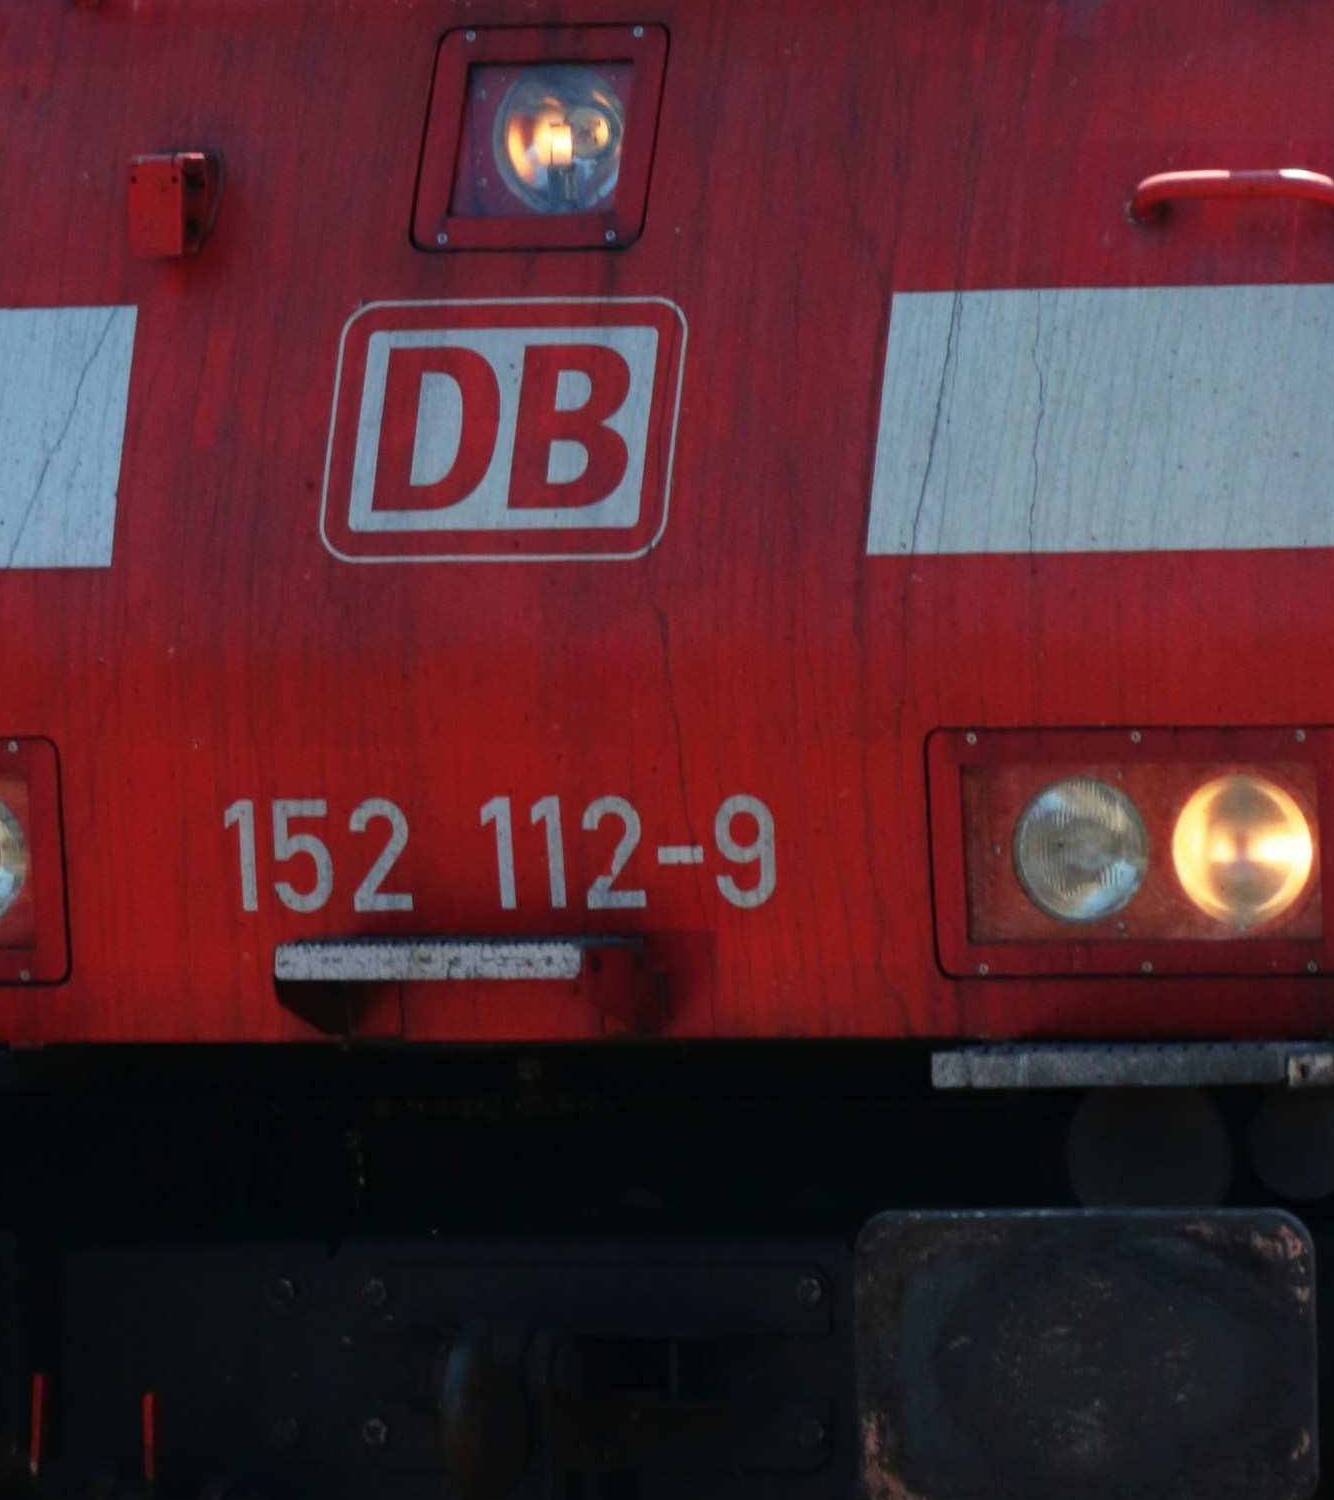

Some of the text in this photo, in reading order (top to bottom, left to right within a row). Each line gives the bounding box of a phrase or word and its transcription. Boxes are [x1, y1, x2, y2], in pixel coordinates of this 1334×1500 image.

[370, 343, 633, 512] DB
[223, 793, 777, 912] 152 112-9
